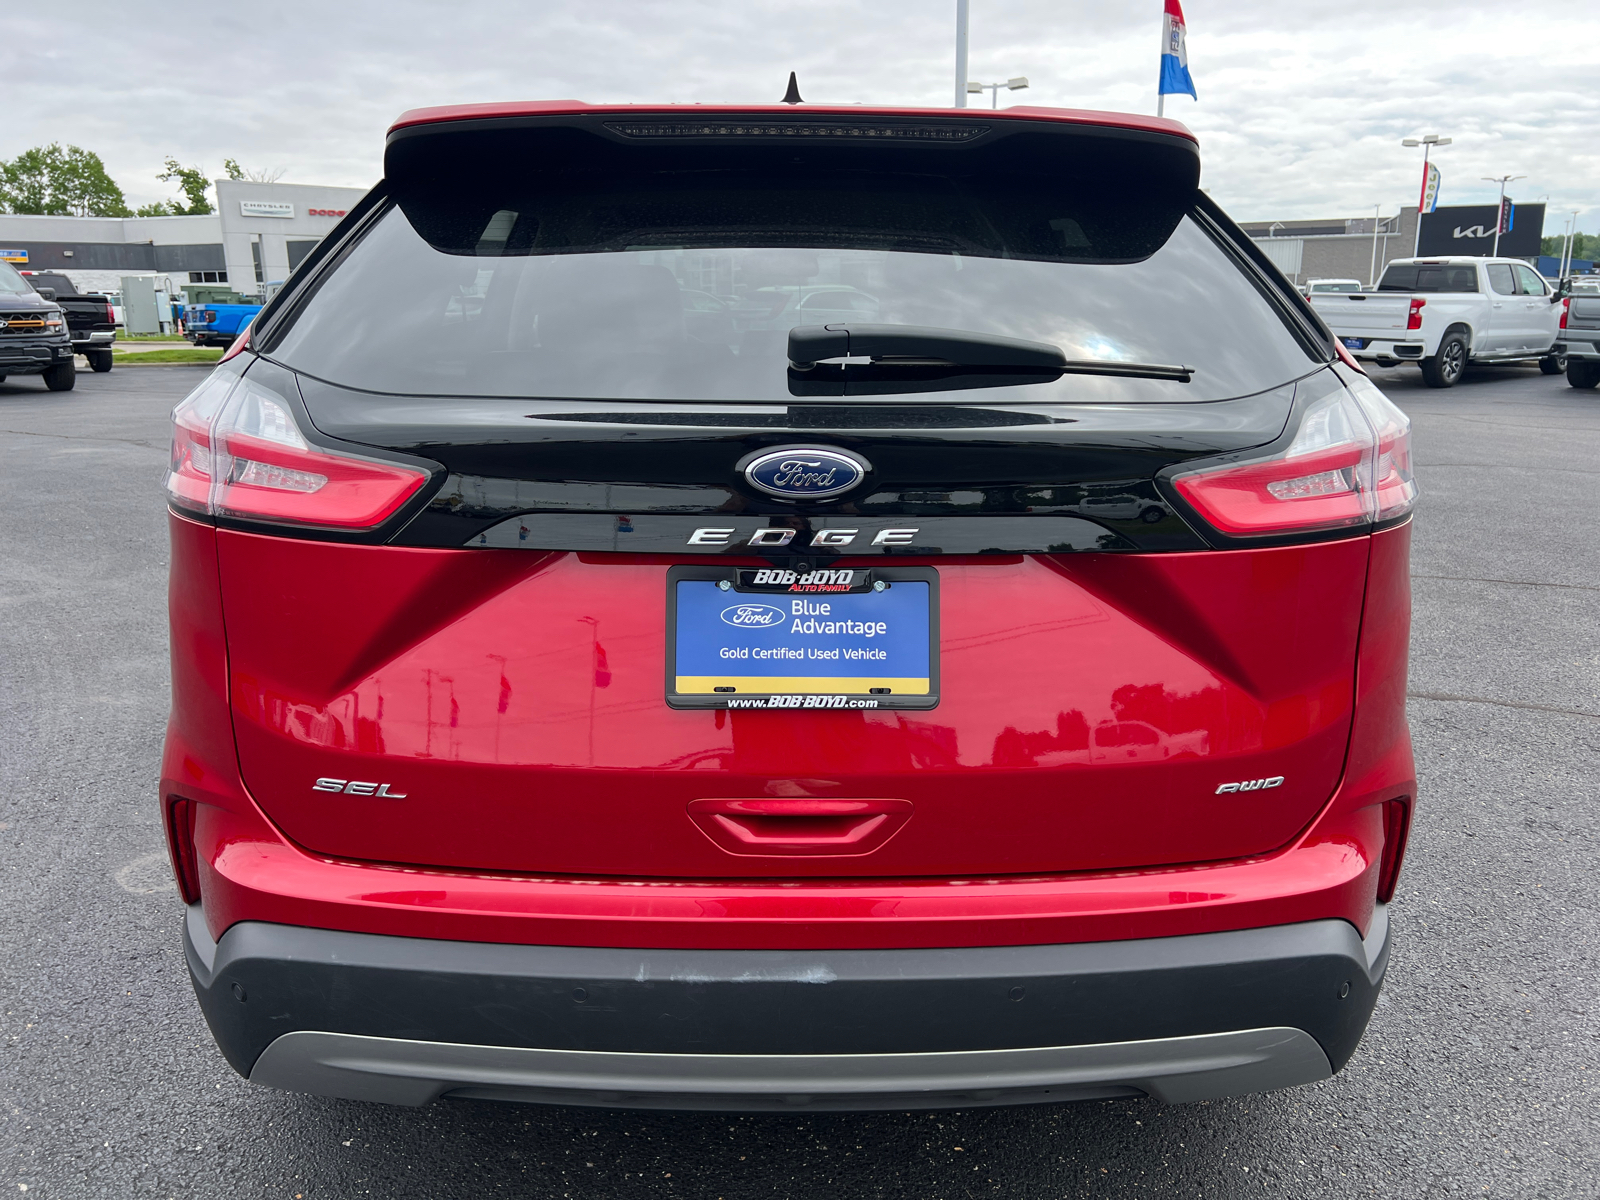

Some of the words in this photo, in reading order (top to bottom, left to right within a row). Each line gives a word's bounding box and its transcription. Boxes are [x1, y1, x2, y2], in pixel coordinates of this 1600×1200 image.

[1425, 173, 1437, 209] Jeep
[243, 202, 291, 210] CHRYSLER
[308, 208, 348, 217] DODG
[774, 460, 837, 487] Ford
[686, 527, 920, 546] EDGE
[733, 606, 774, 624] Ford
[791, 600, 831, 615] Blue
[791, 618, 887, 637] Advantage
[719, 647, 749, 659] Gold
[752, 647, 804, 659] Certified
[808, 648, 839, 659] Used
[843, 648, 887, 660] Vehicle
[312, 777, 408, 799] SEL
[1215, 776, 1285, 795] AWD
